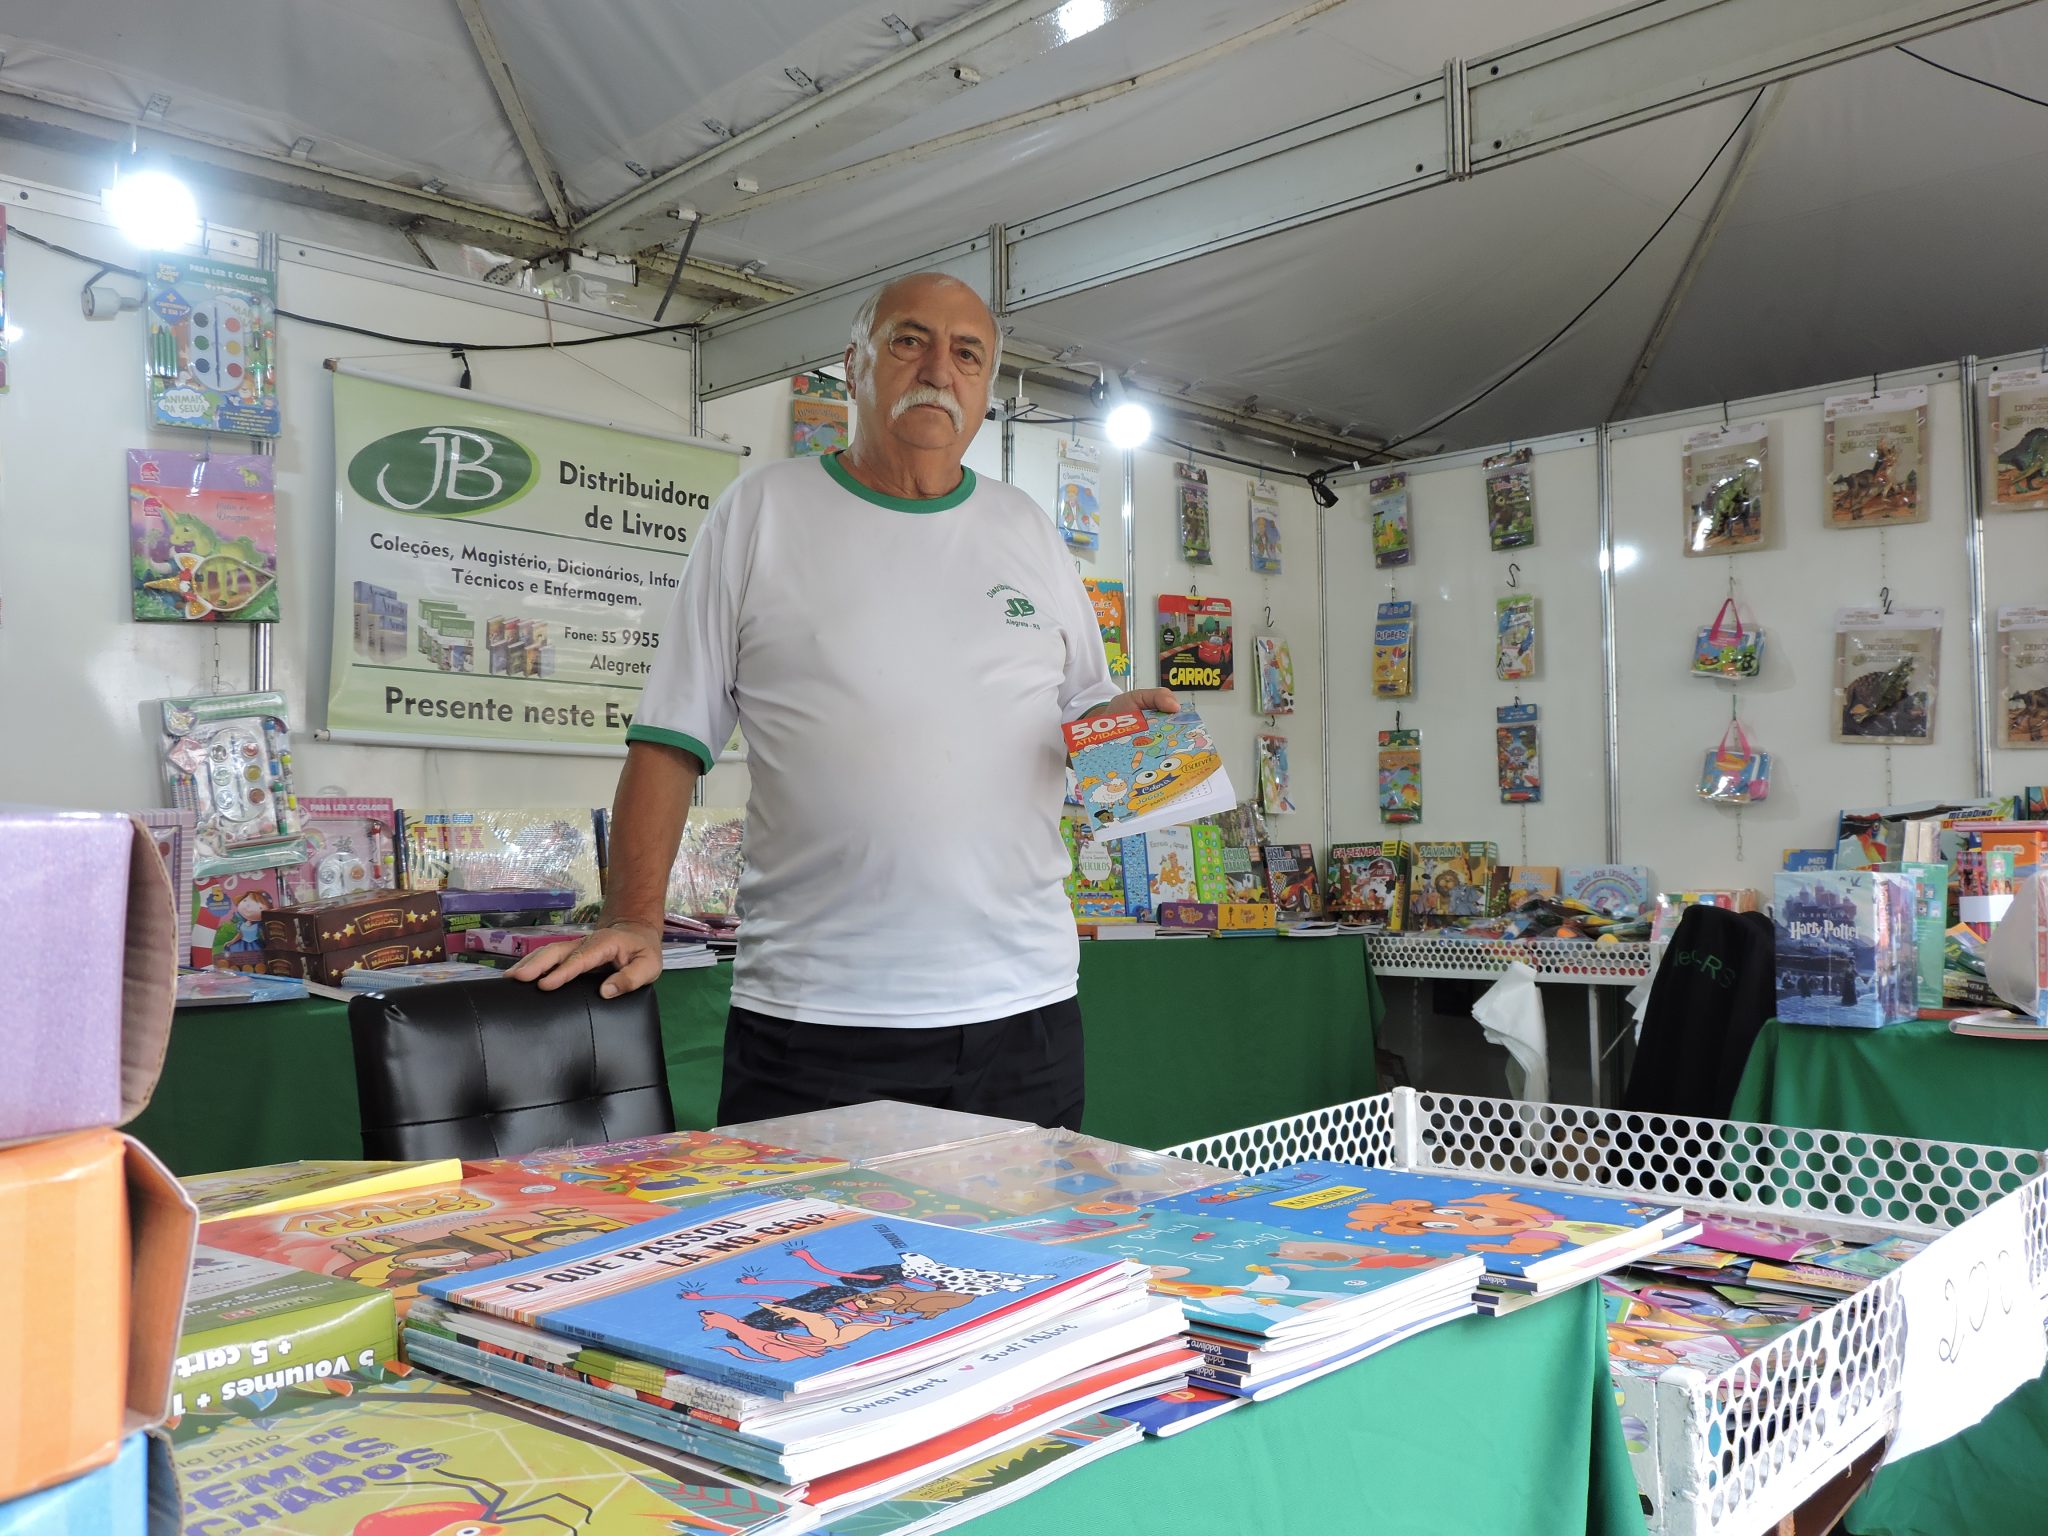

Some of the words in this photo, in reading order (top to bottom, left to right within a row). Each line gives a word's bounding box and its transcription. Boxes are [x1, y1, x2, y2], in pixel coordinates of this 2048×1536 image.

[164, 404, 176, 413] DA
[179, 404, 206, 414] SELVA
[165, 394, 204, 405] ANIMAIS
[377, 427, 503, 510] JB
[560, 460, 710, 510] Distribuidora
[585, 505, 613, 531] de
[622, 510, 687, 543] Livros
[370, 533, 455, 560] Coleções,
[461, 545, 551, 574] Magistério,
[557, 558, 644, 586] Dicionários,
[451, 567, 524, 592] Técnicos
[530, 582, 539, 593] e
[544, 581, 642, 606] Enfermagem.
[1004, 597, 1036, 618] JB
[564, 626, 597, 642] Fone:
[601, 631, 617, 644] 55
[622, 629, 660, 649] 9955
[1376, 630, 1407, 641] ALFABETO
[1169, 667, 1221, 686] CARROS
[385, 686, 513, 722] Presente
[524, 704, 595, 728] neste
[1071, 713, 1138, 741] 505
[1075, 724, 1141, 747] ATIVIDADES
[1136, 791, 1165, 804] JOGOS
[413, 826, 484, 853] T-REX
[1419, 845, 1462, 857] SAVANA
[1333, 845, 1382, 858] FAZENDA
[1808, 856, 1827, 865] MEU
[1269, 860, 1299, 872] CORRIDA
[1790, 921, 1823, 940] Harry
[1823, 919, 1861, 941] Potter
[318, 1199, 481, 1233] FELICES
[661, 1244, 702, 1269] LÁ
[710, 1232, 761, 1257] NO
[767, 1211, 833, 1236] CÉU?
[506, 1282, 541, 1293] O
[554, 1256, 623, 1285] QUE
[629, 1220, 751, 1263] PASSOU
[251, 1339, 269, 1365] 5
[1191, 1340, 1222, 1355] Todolivro
[175, 1346, 241, 1380] cart
[841, 1391, 902, 1415] Owen
[902, 1377, 949, 1398] Hart
[981, 1342, 1028, 1363] Judi
[1029, 1322, 1078, 1346] Abbot
[222, 1356, 350, 1401] volumes
[207, 1435, 281, 1458] Pirillo
[305, 1426, 357, 1446] DE
